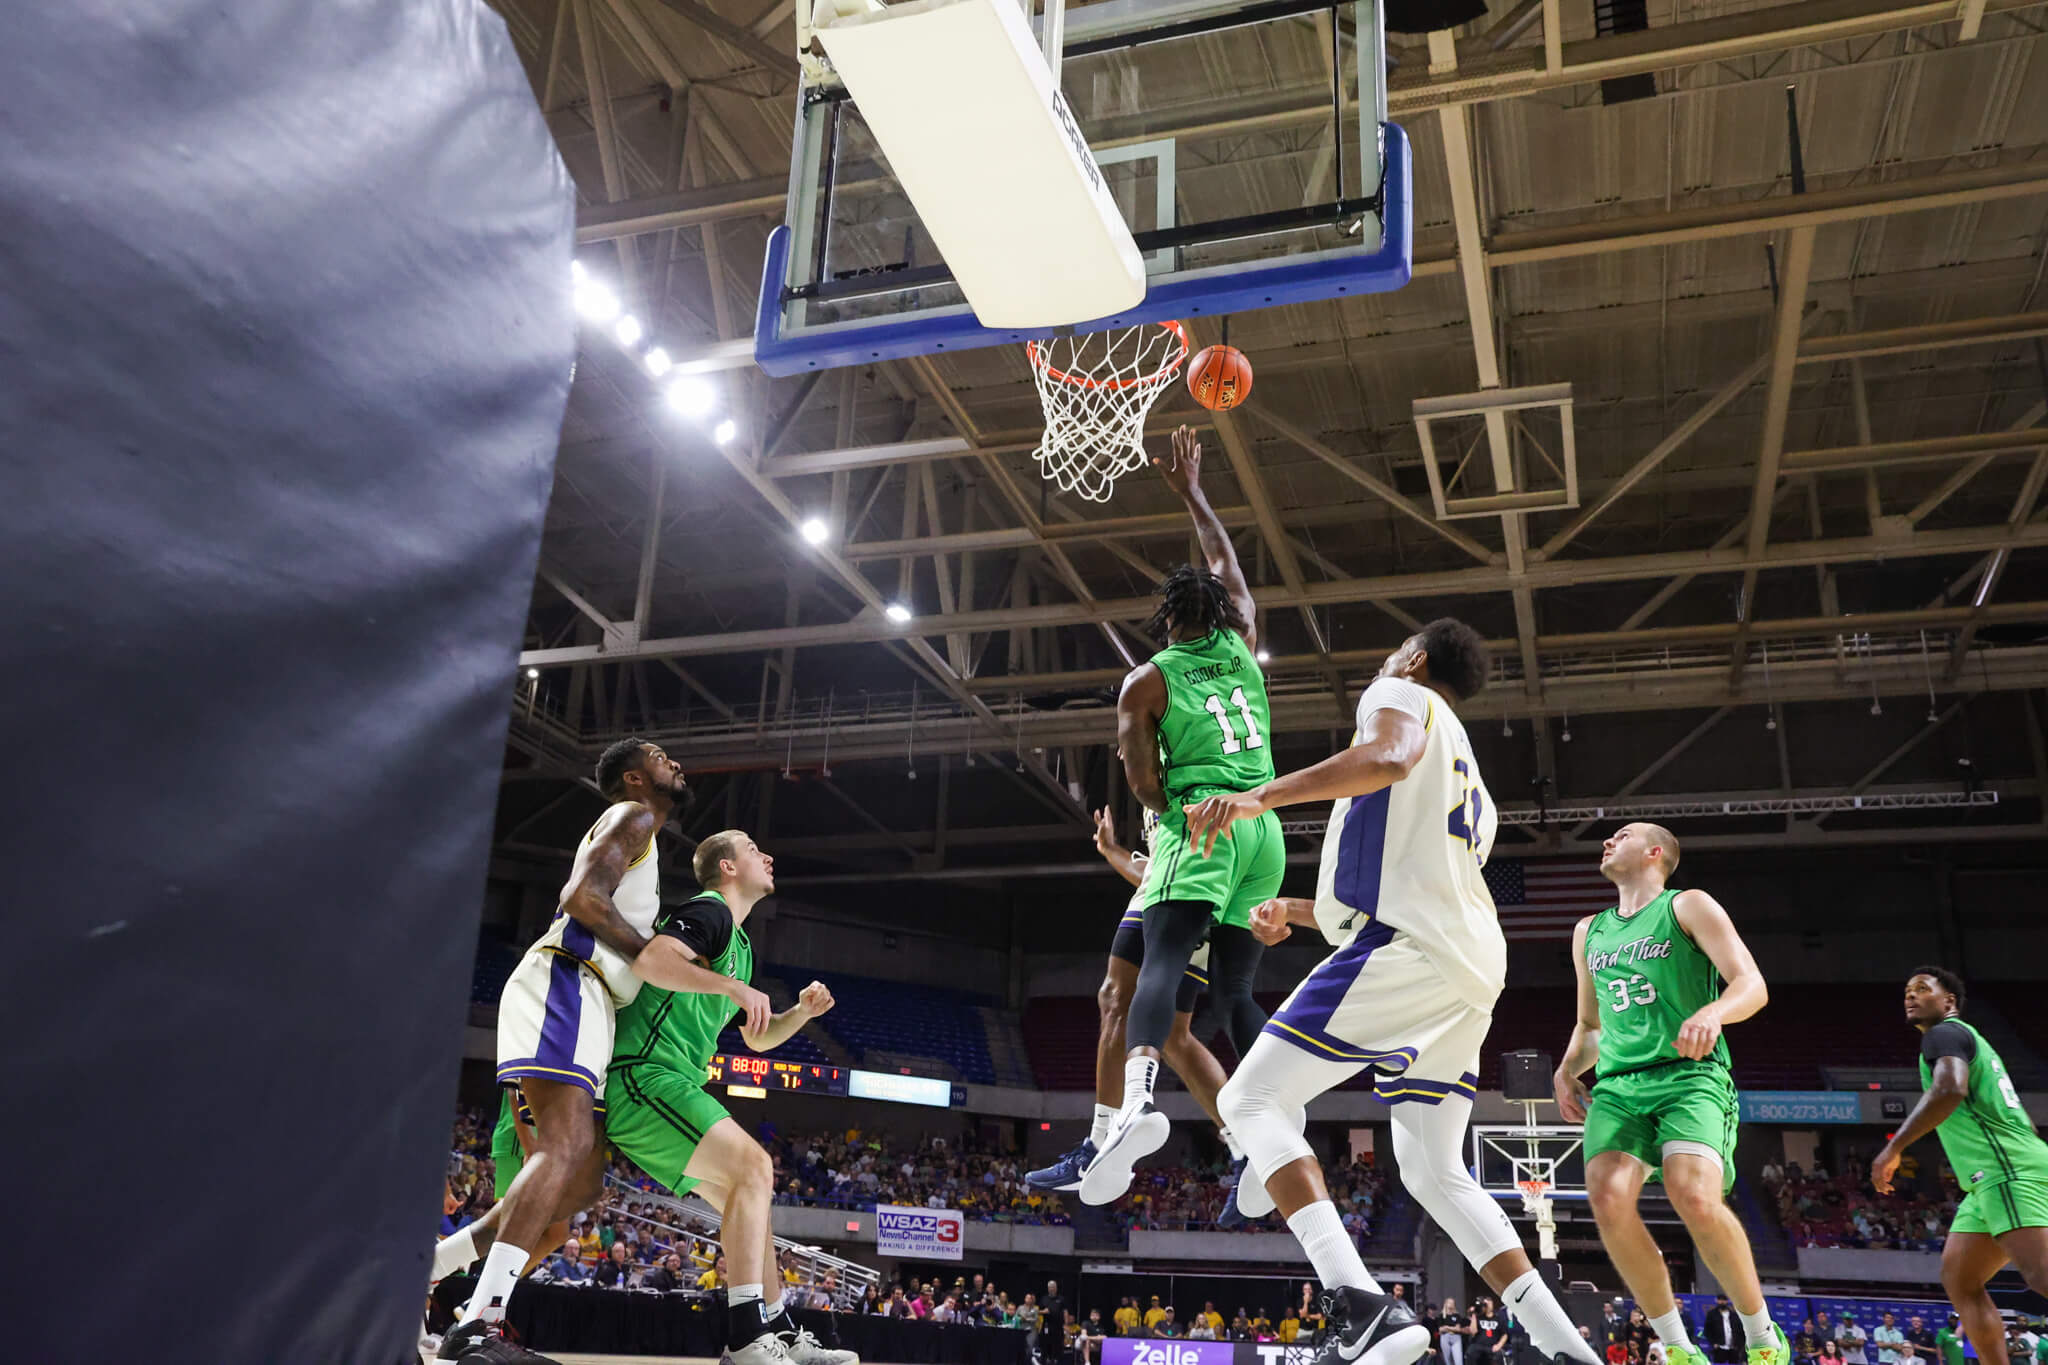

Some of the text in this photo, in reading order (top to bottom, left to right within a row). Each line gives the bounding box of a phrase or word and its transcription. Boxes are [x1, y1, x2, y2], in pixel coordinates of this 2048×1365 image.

[1183, 656, 1247, 685] COOKE JR.
[1204, 685, 1263, 755] 11
[1624, 936, 1672, 965] That
[1607, 974, 1657, 1013] 33
[731, 1057, 769, 1075] 88:00
[1747, 1104, 1857, 1120] 1-800-273-TALK
[880, 1214, 936, 1230] WSAZ
[880, 1219, 959, 1243] NewsChannel 3
